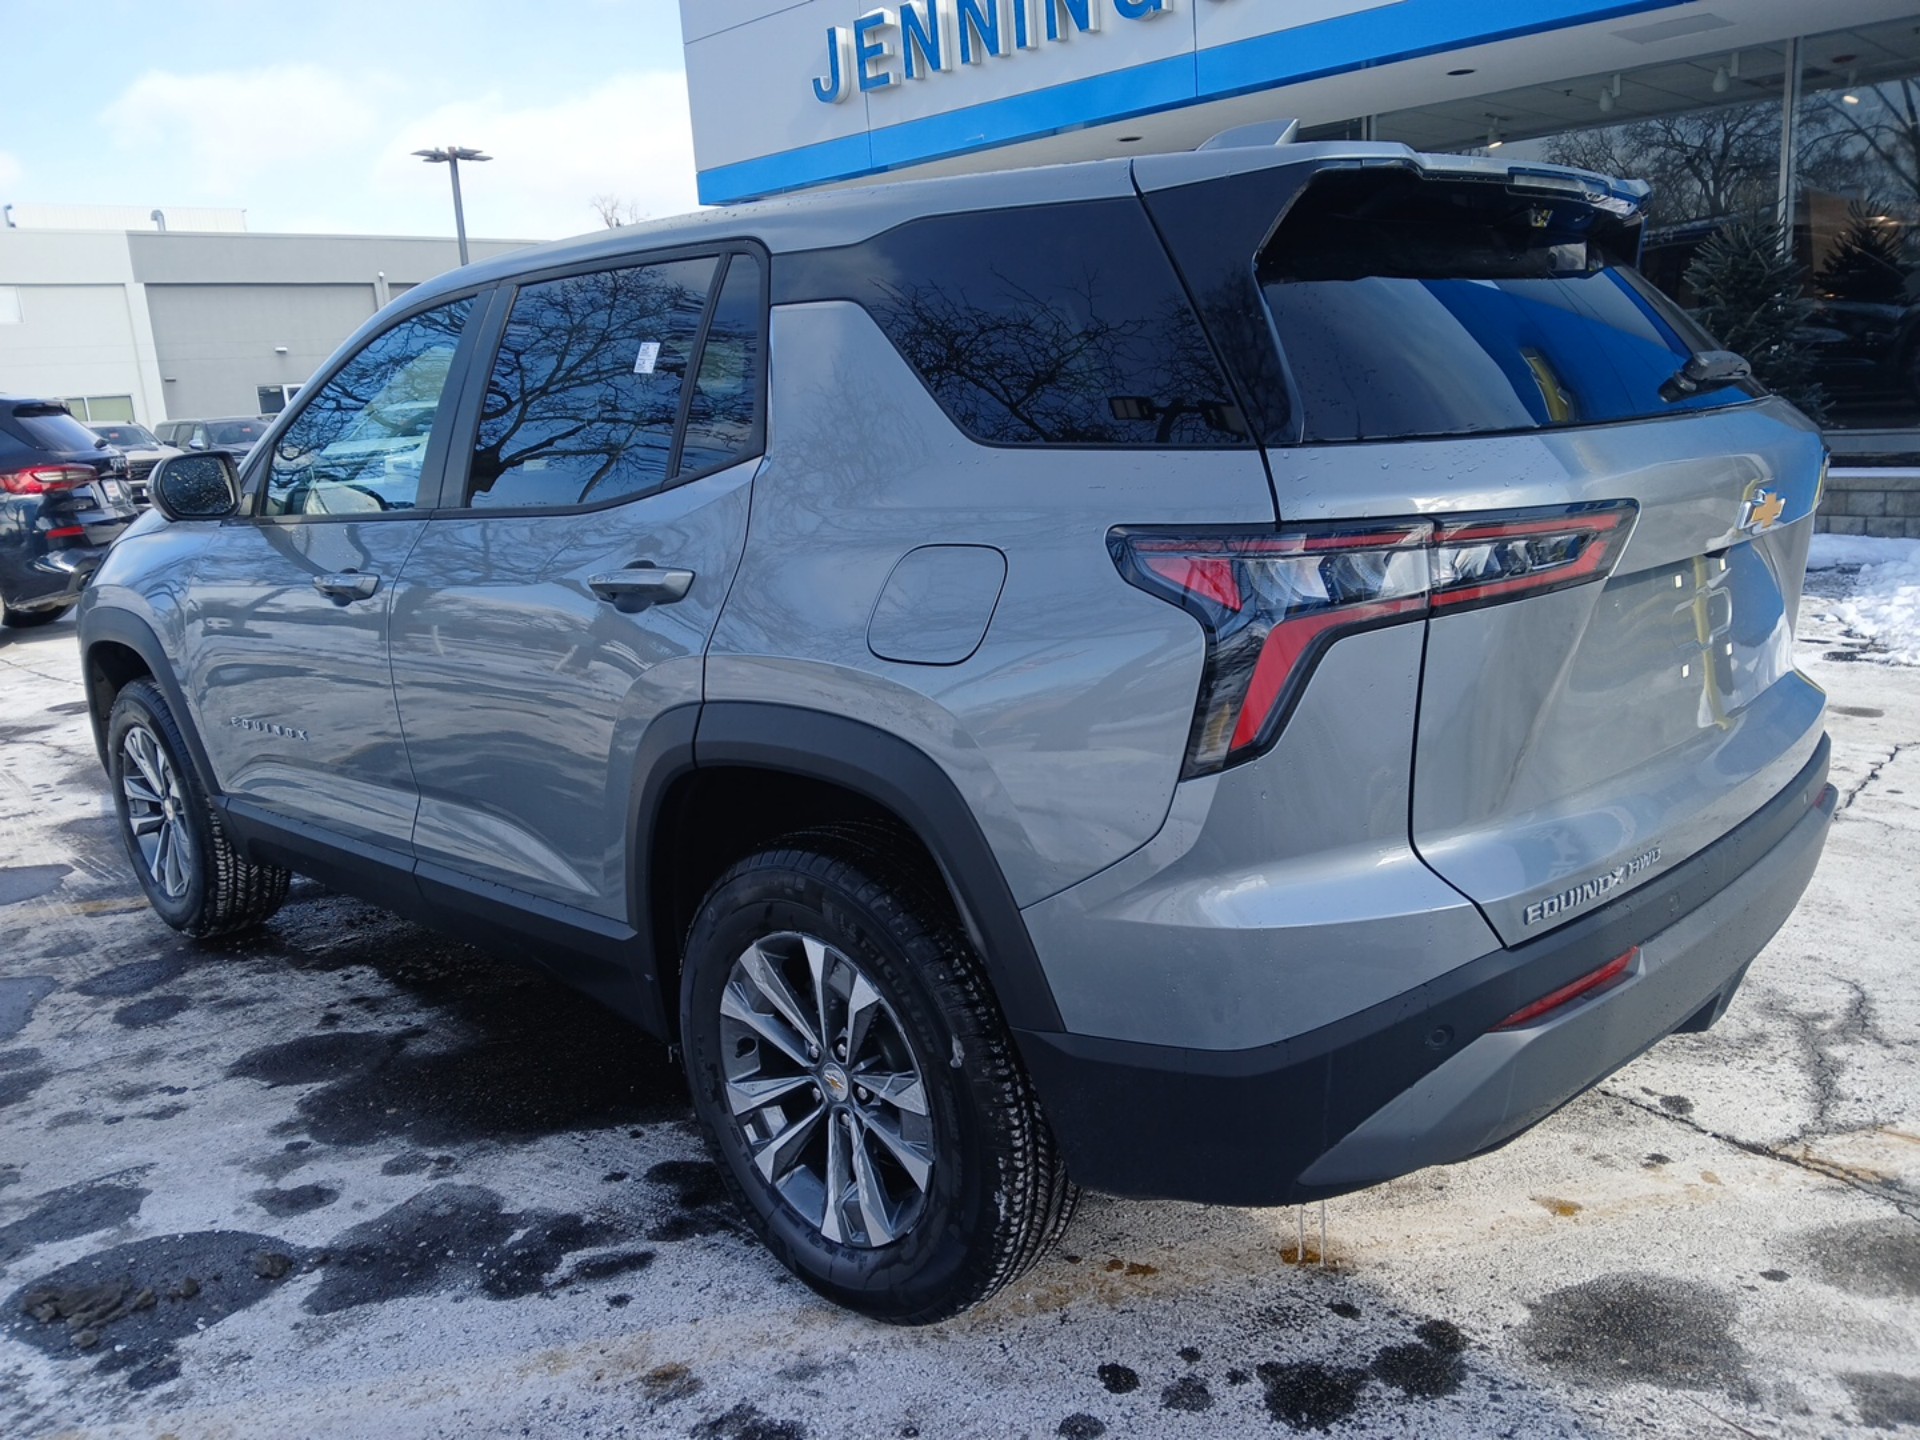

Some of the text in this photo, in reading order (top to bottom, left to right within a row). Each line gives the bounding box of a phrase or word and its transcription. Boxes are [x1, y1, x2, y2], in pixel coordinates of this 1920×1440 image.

[813, 0, 1173, 104] JENNI
[1525, 847, 1661, 925] EQUINOX AWD
